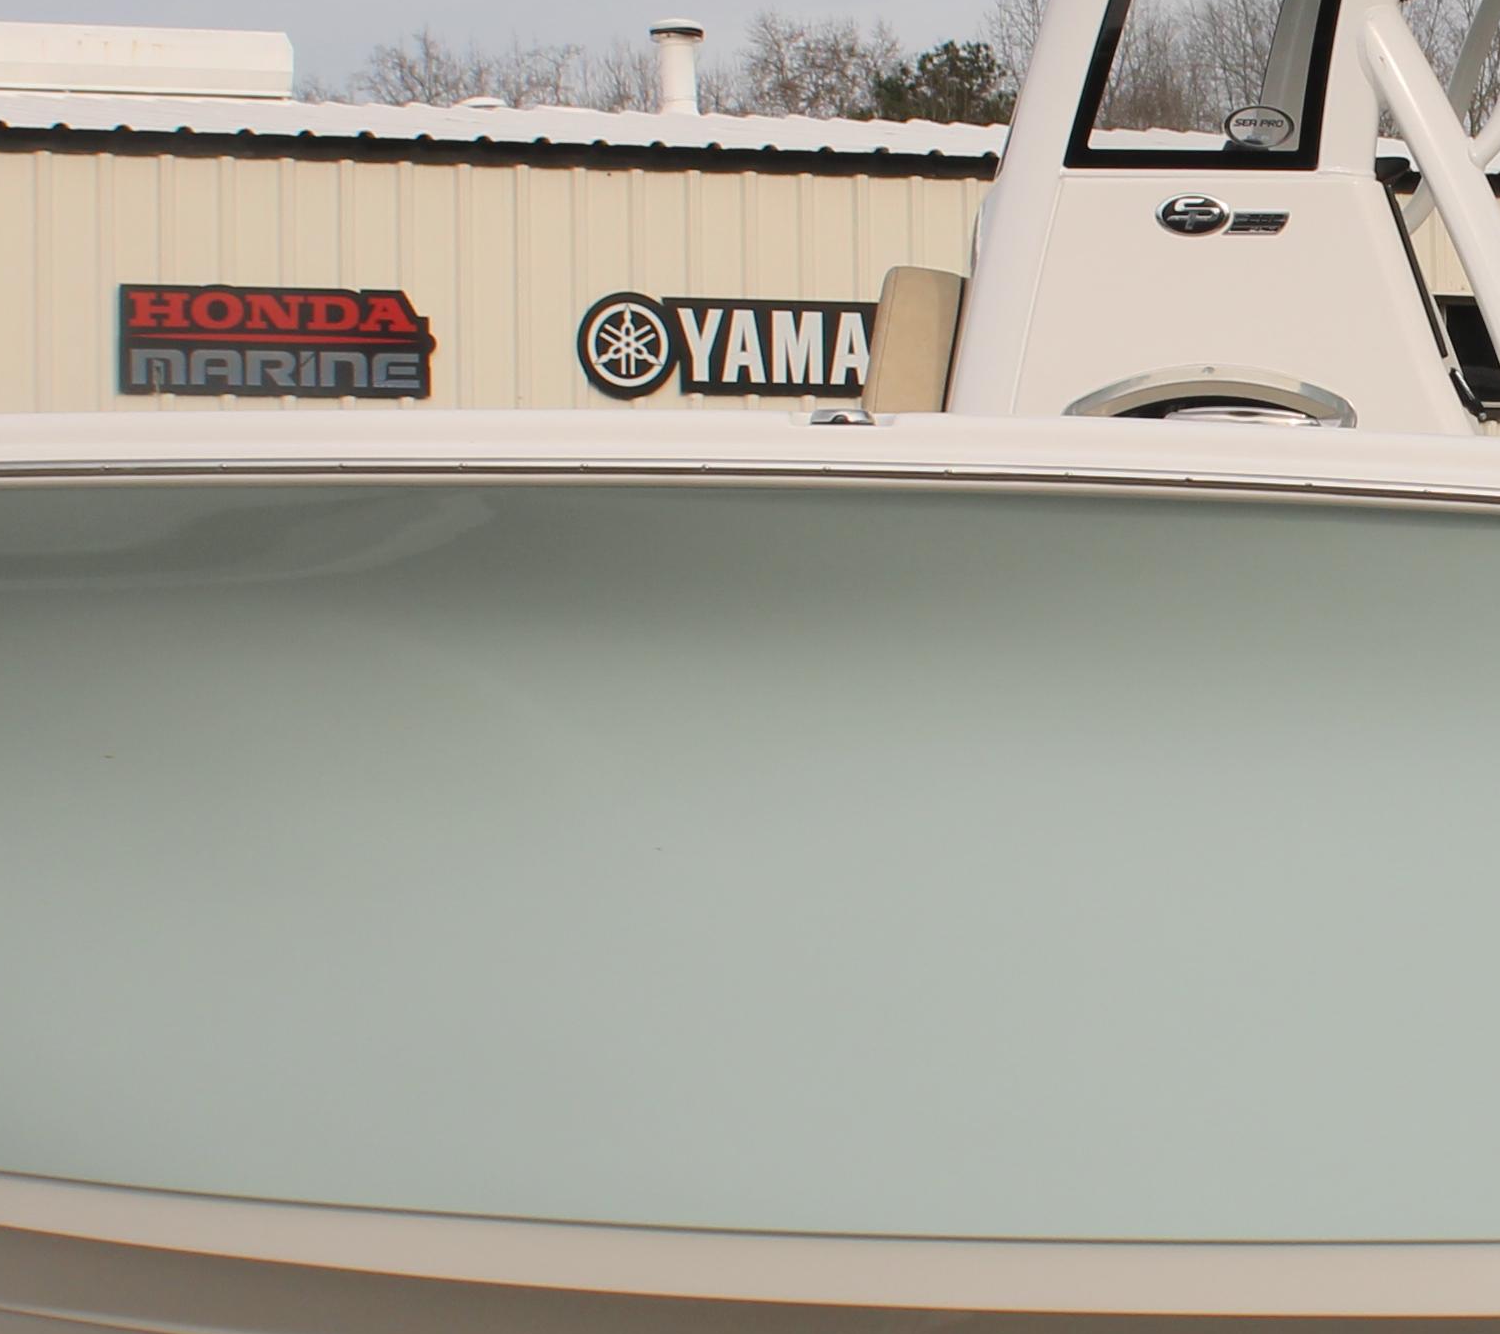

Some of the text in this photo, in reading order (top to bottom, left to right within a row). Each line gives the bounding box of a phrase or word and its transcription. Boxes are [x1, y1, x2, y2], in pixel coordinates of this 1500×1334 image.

[1233, 118, 1284, 128] SEA PRO
[128, 291, 417, 332] HONDA
[131, 348, 420, 389] MARINE
